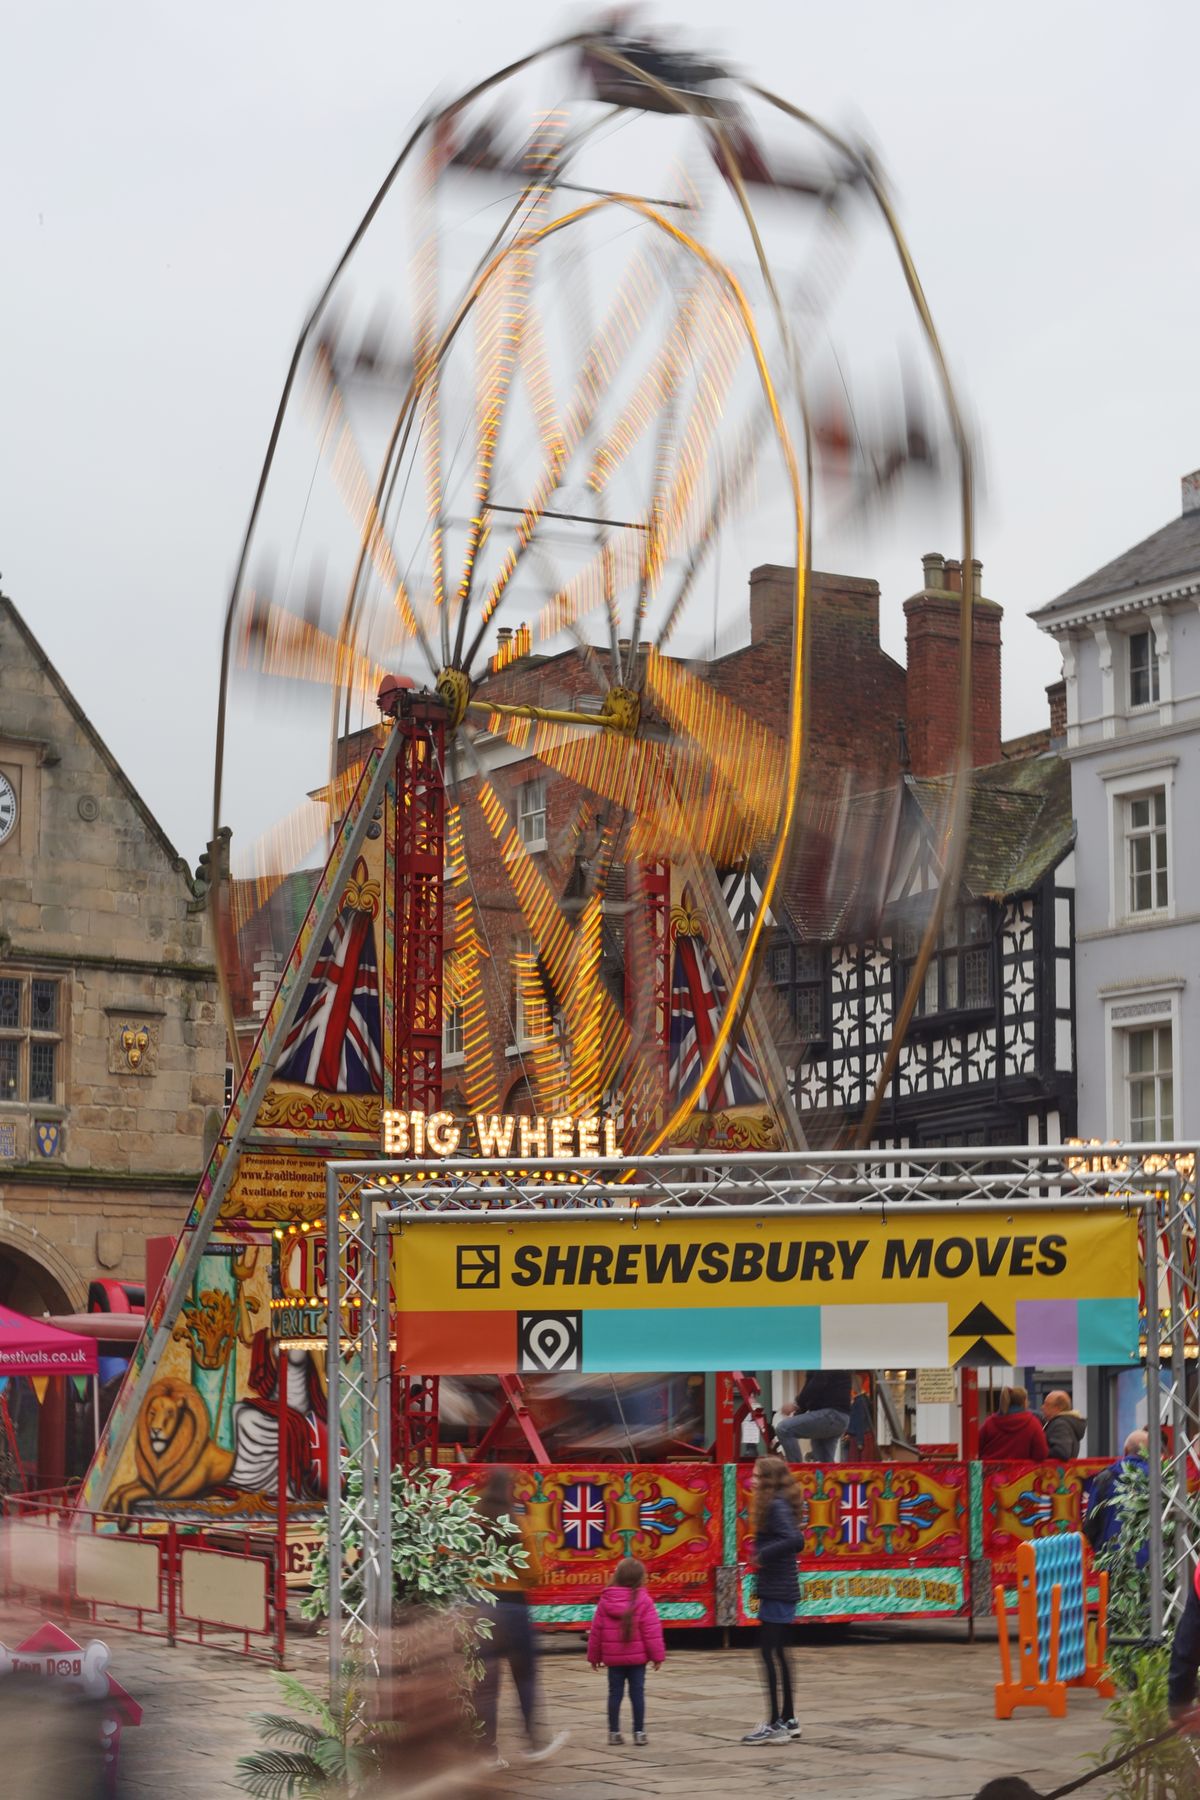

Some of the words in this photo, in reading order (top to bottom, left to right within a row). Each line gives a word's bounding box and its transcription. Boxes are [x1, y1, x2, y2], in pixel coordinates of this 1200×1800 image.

[383, 1110, 460, 1155] BIG
[476, 1114, 623, 1157] WHEEL
[241, 1187, 288, 1197] Available
[290, 1189, 306, 1198] for
[307, 1191, 327, 1200] you
[512, 1240, 869, 1287] SHREWSBURY
[882, 1234, 1067, 1280] MOVES
[281, 1310, 324, 1336] EXIT
